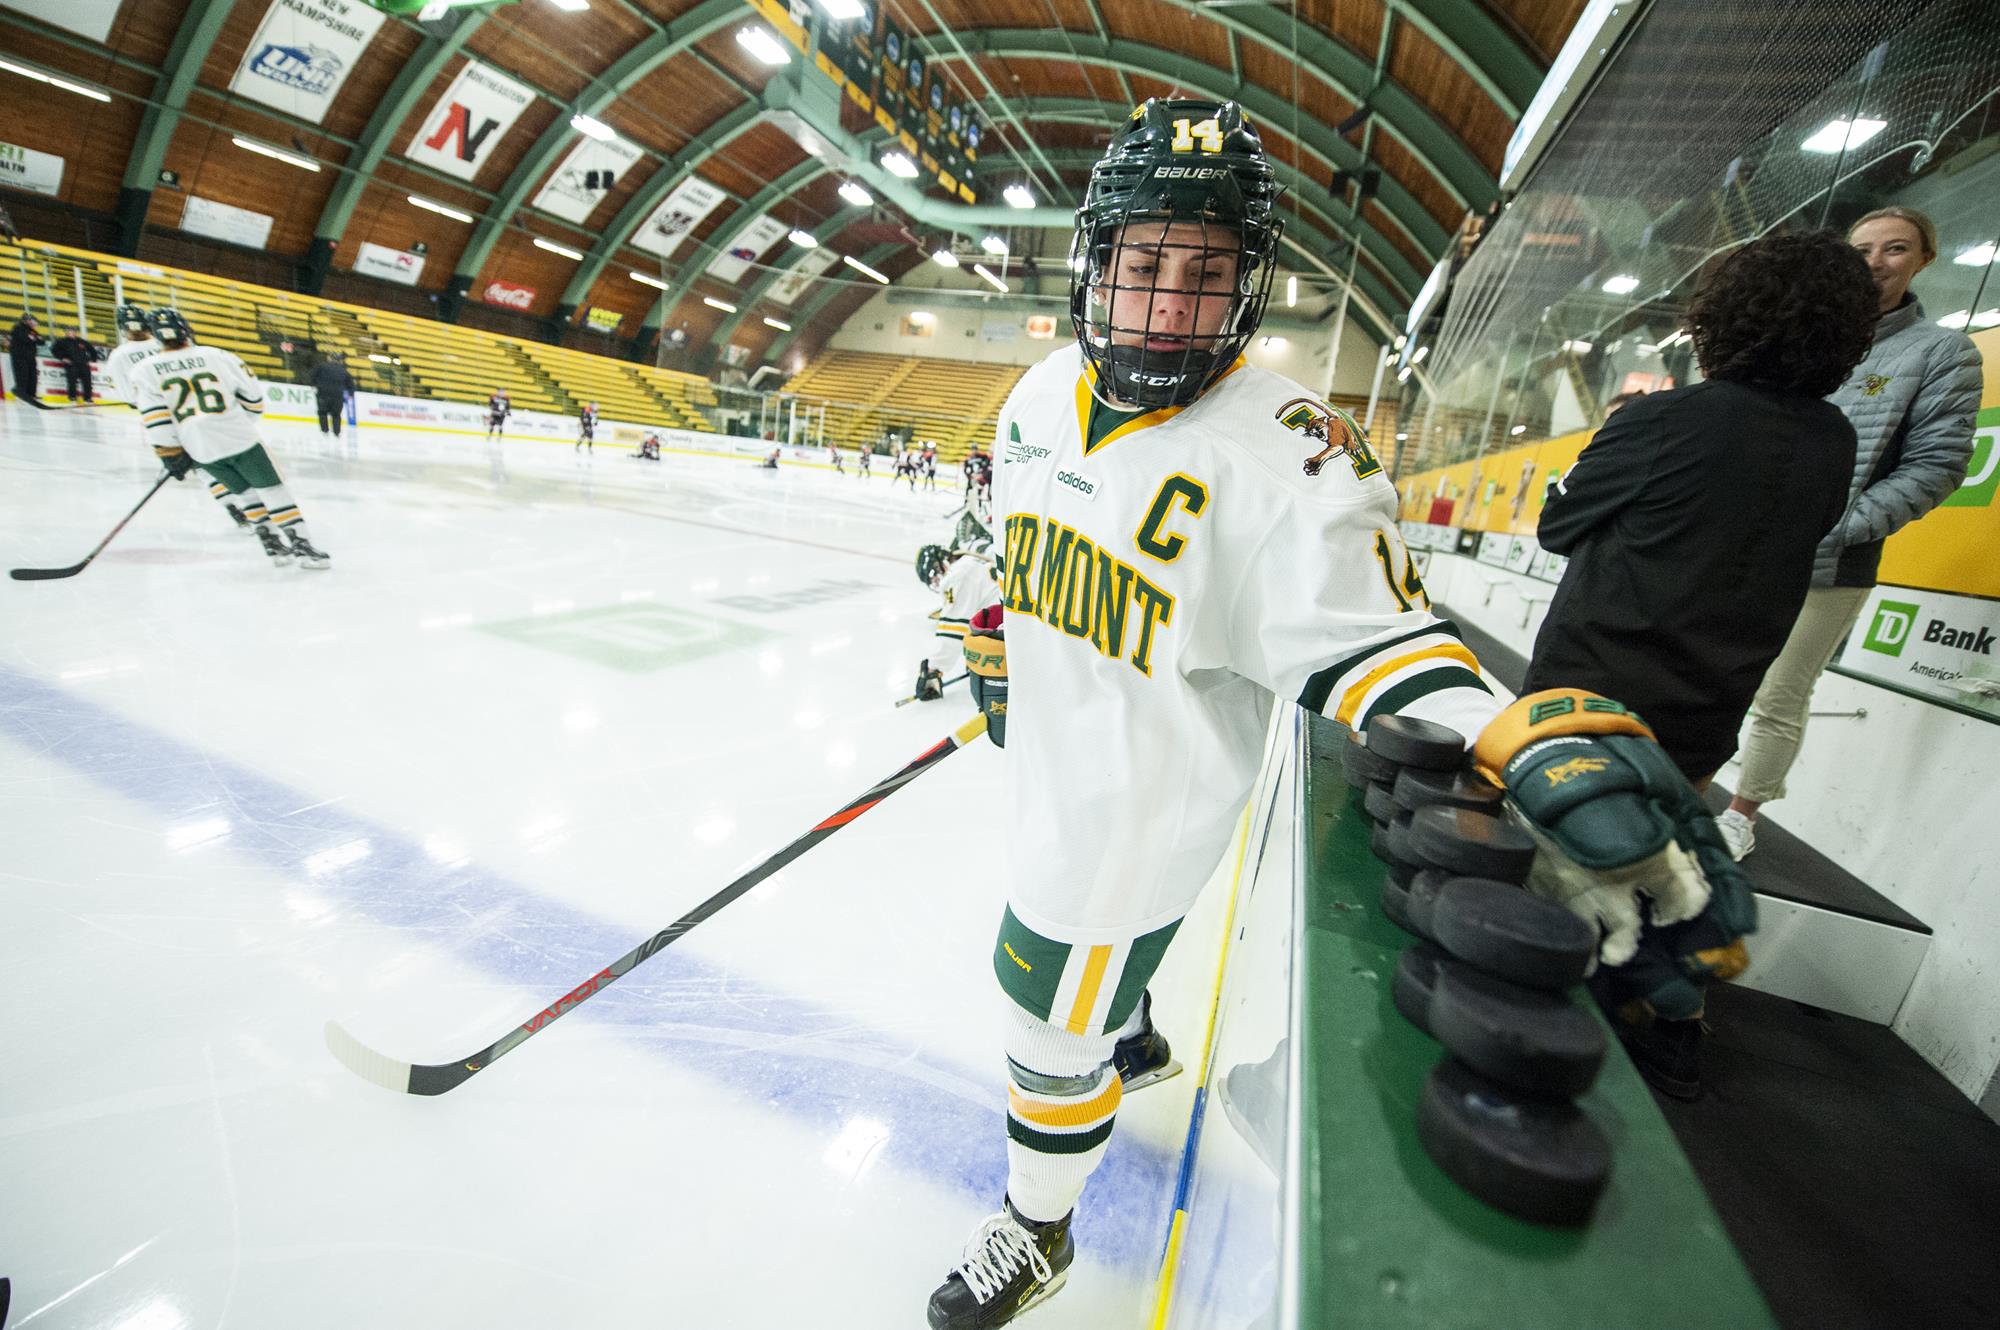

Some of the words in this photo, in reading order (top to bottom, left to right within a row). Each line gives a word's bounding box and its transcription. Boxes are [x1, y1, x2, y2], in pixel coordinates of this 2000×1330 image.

[425, 101, 500, 163] N
[1171, 118, 1224, 153] 14
[1153, 165, 1229, 181] BAUER
[153, 356, 207, 375] PICARD
[1128, 371, 1185, 387] CCM
[161, 372, 226, 423] 26
[1016, 453, 1033, 465] EAST
[1019, 444, 1052, 459] HOCKEY
[1057, 468, 1095, 495] adidas
[1133, 471, 1211, 566] C
[1004, 511, 1176, 680] ERMONT
[1923, 618, 1997, 655] Bank
[1003, 942, 1032, 973] BAUER
